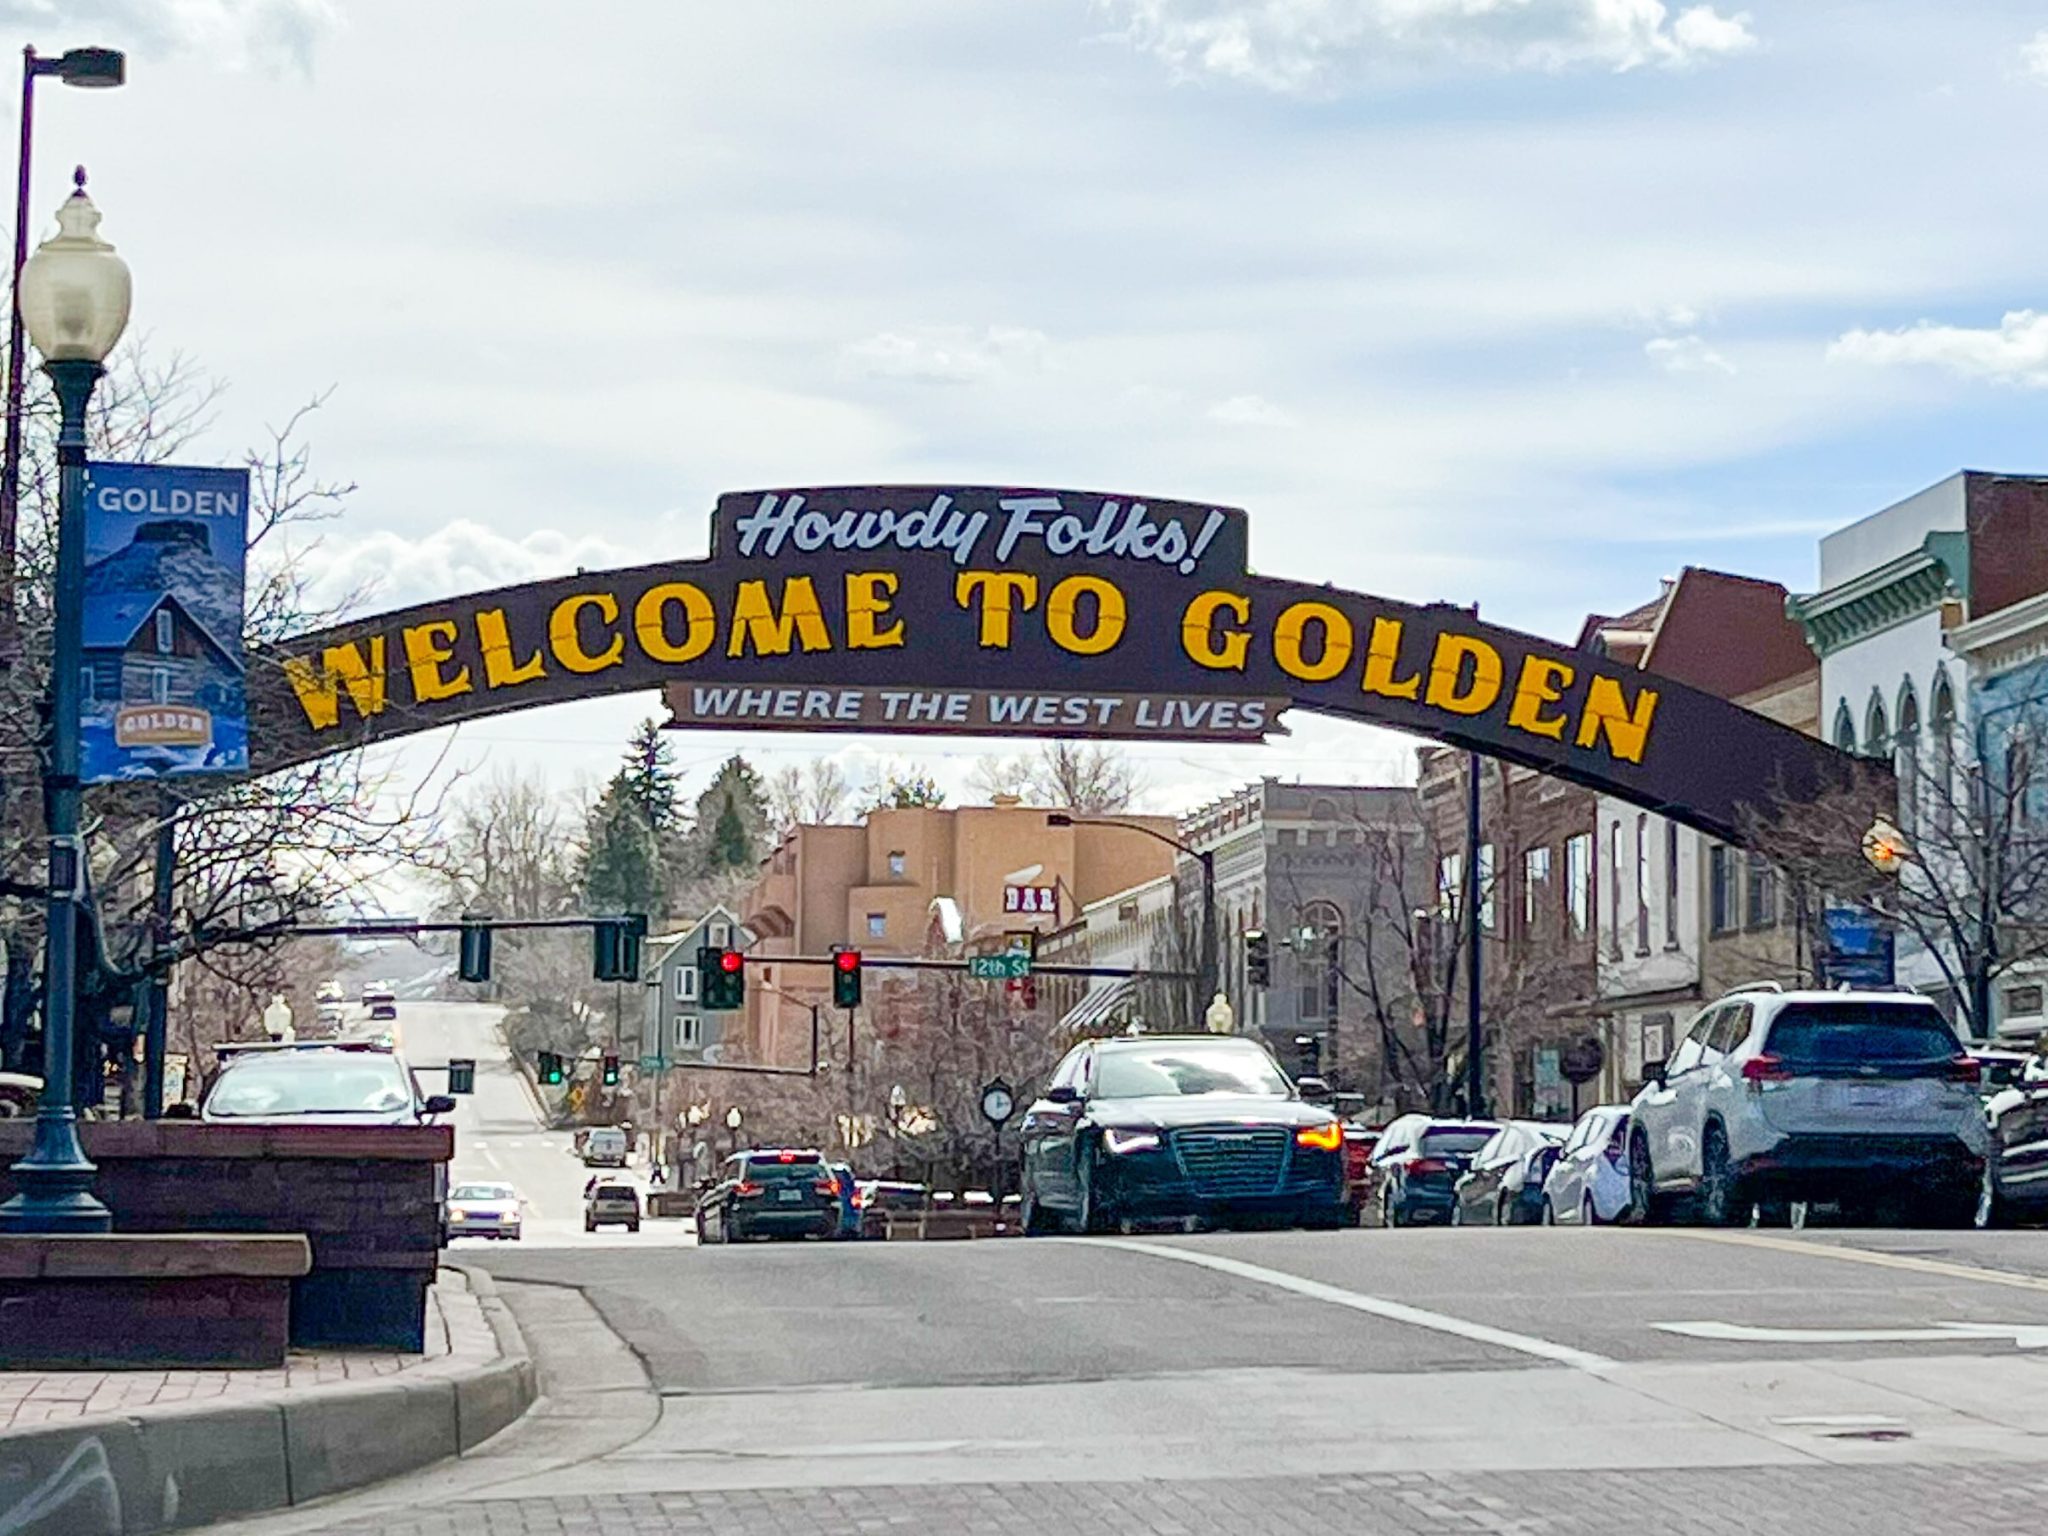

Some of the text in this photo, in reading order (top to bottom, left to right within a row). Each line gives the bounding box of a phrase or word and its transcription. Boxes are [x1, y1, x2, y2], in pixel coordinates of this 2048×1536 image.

[97, 486, 241, 517] GOLDEN
[736, 494, 1226, 576] Howdy Folks!
[283, 571, 1659, 764] WELCOME TO GOLDEN
[693, 687, 1266, 731] WHERE THE WEST LIVES
